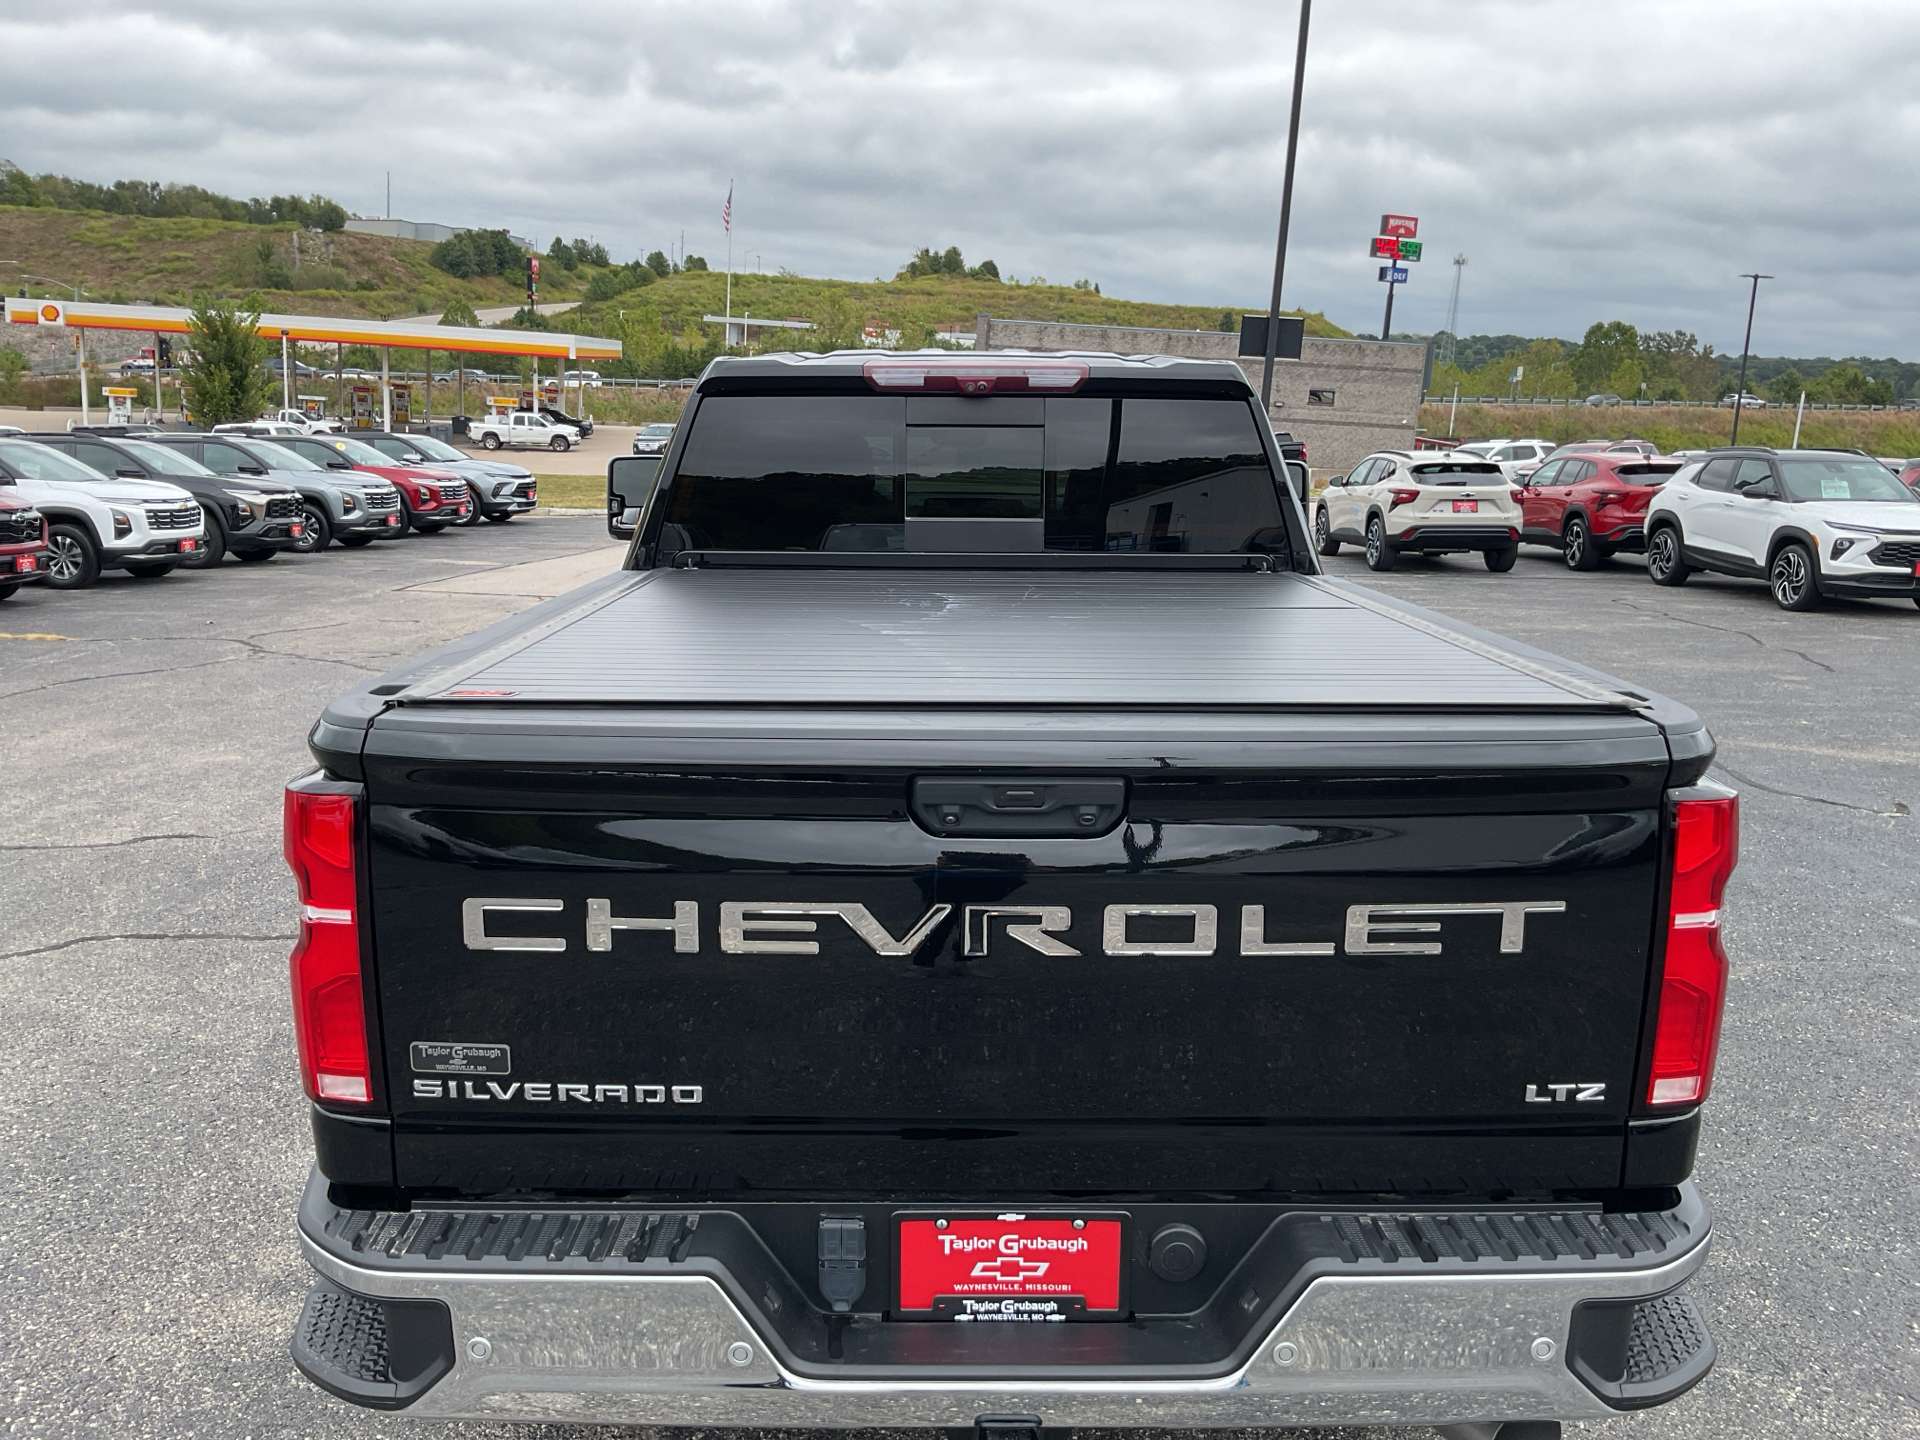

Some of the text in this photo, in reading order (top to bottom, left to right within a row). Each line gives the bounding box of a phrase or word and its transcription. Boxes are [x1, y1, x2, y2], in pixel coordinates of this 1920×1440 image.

[1388, 218, 1416, 232] MAVERIK
[1393, 272, 1406, 280] DEF
[462, 897, 1567, 958] CHEVROLET
[418, 1045, 501, 1059] Taylor Grubaugh
[412, 1079, 703, 1104] SILVERADO
[1525, 1083, 1606, 1102] LTZ
[938, 1234, 1088, 1255] Taylor Grubaugh
[953, 1283, 1072, 1291] WAYNESVILLE, MISSOURI
[962, 1299, 1058, 1314] Taylor Grubaugh
[976, 1313, 1044, 1321] WAYNESVILLE, MO
